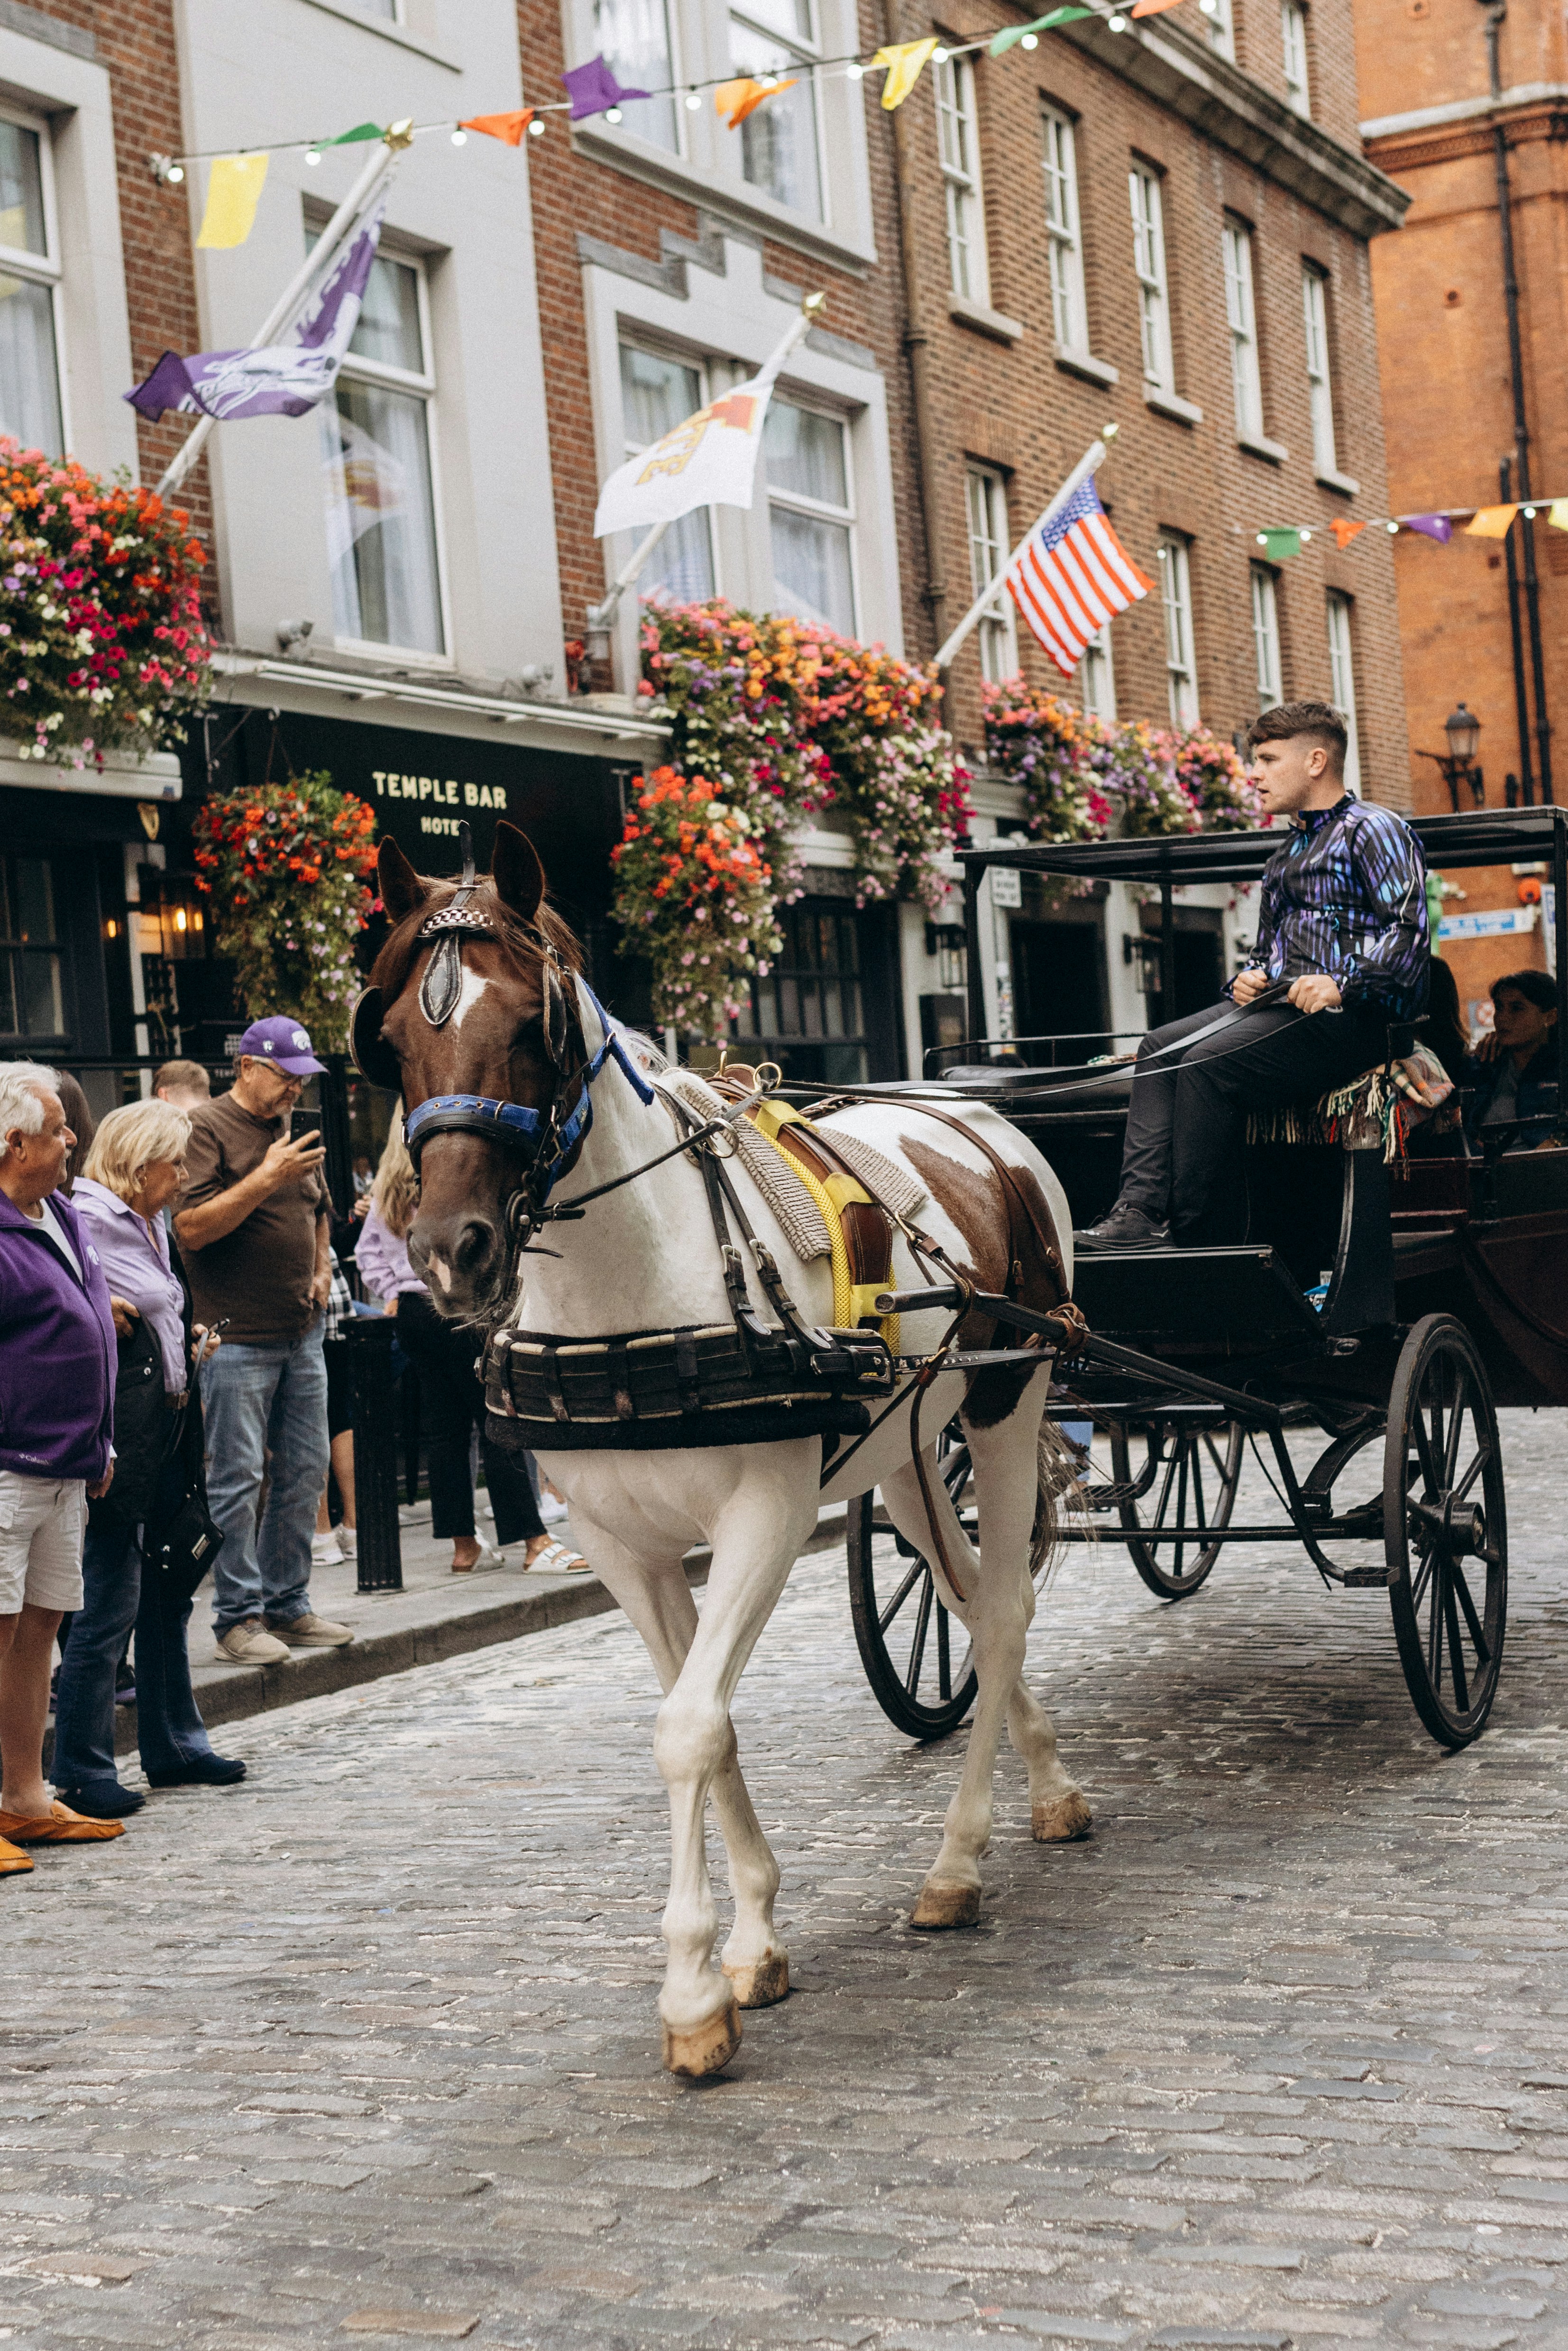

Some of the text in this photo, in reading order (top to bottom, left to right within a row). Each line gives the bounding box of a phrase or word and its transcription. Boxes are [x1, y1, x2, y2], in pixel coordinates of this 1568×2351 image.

[372, 771, 507, 809] TEMPLE BAR
[421, 817, 459, 836] HOTE
